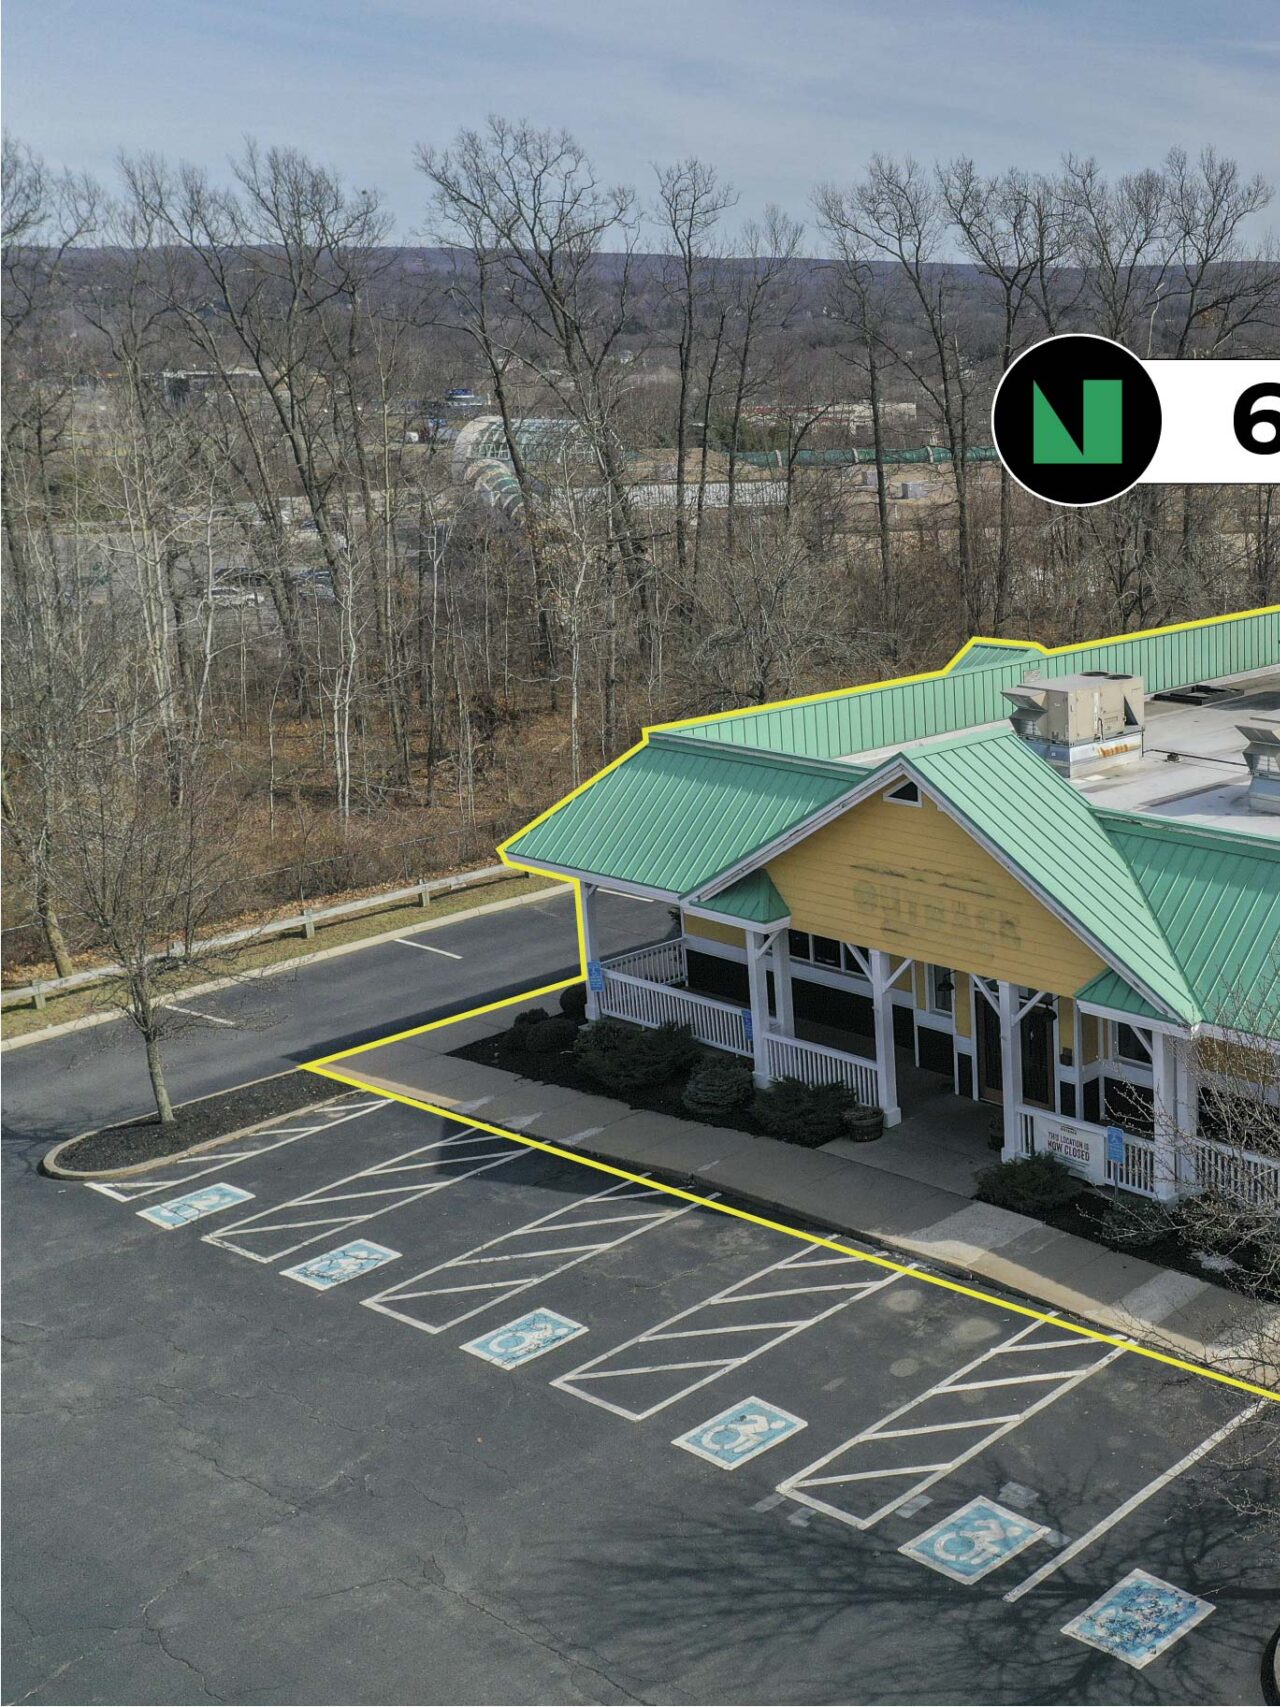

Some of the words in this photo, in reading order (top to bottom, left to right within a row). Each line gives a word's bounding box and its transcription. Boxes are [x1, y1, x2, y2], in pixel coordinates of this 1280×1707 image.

[1047, 1140, 1063, 1152] NOW
[1064, 1145, 1089, 1161] CLOSED
[1048, 1132, 1059, 1141] THIS
[1060, 1136, 1083, 1148] LOCATION
[1084, 1143, 1089, 1151] IS
